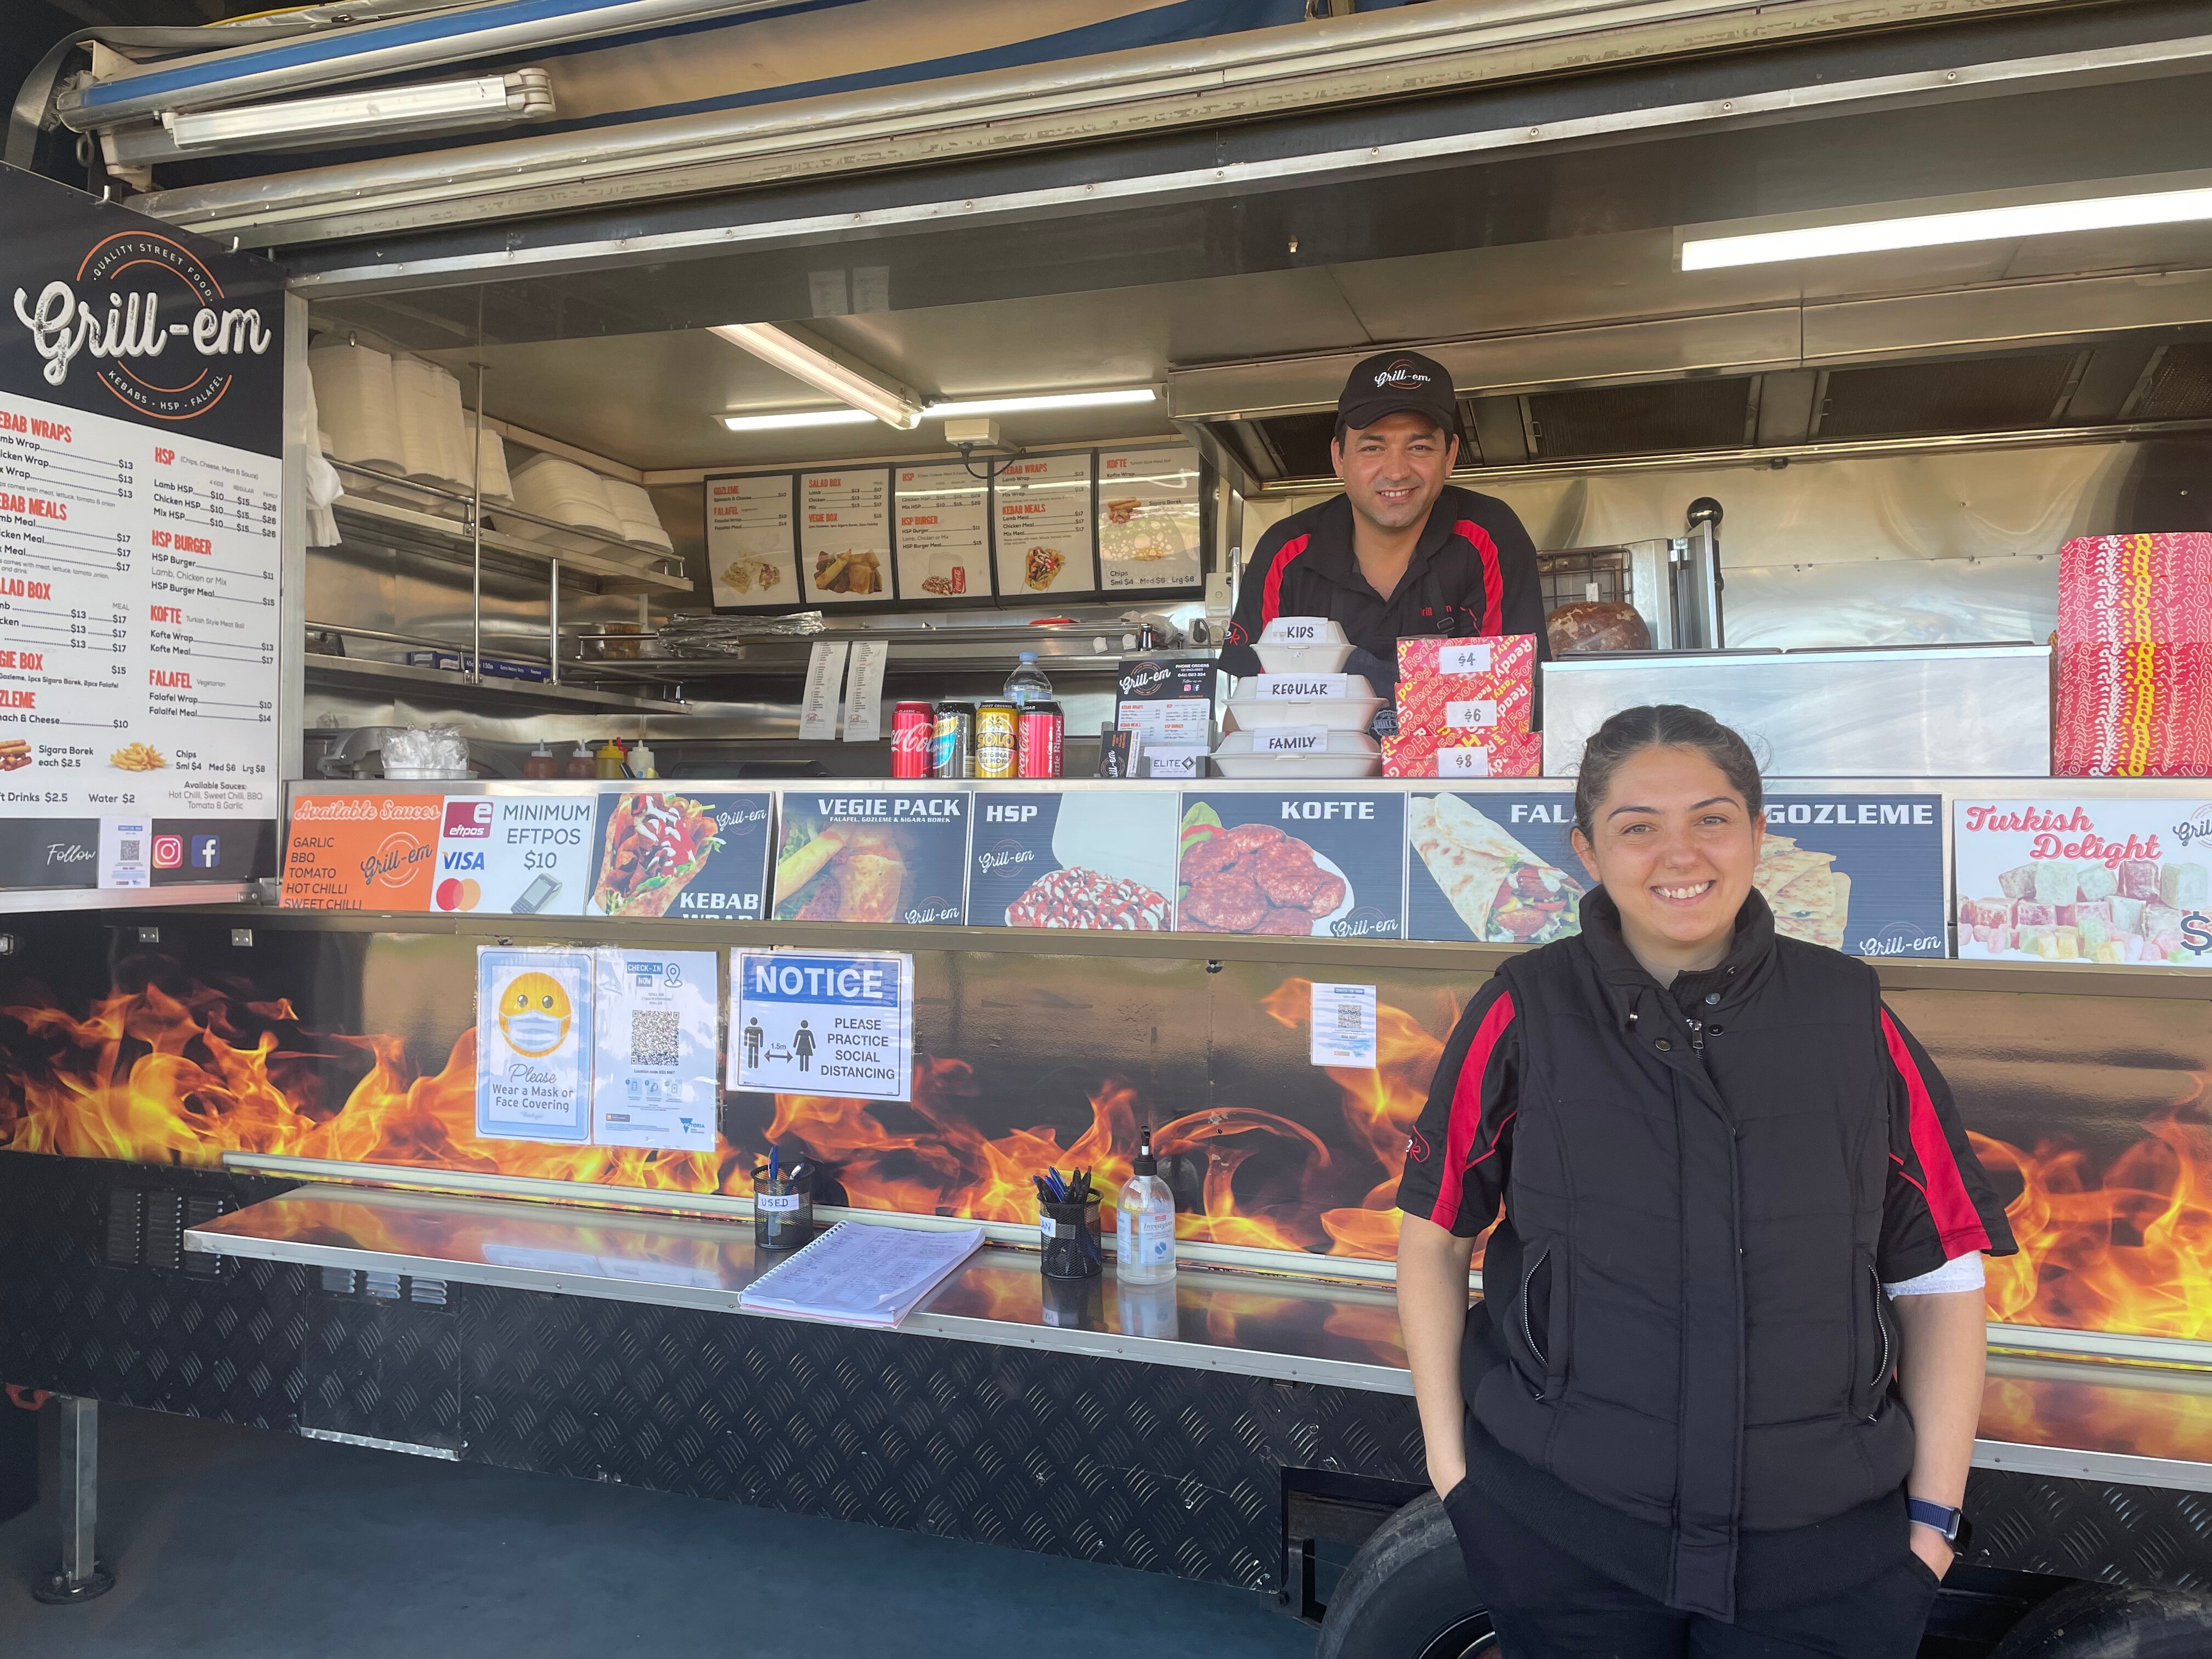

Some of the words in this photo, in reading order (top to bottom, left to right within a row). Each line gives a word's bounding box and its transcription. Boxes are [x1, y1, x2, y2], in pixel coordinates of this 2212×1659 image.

[94, 243, 134, 278] QUALITY
[139, 243, 183, 266] STREET
[188, 267, 212, 298] FOOD
[14, 281, 272, 386] Grill-em
[1374, 369, 1431, 387] Grill-em
[109, 370, 148, 404] KEBABS
[160, 401, 180, 410] HSP
[190, 375, 223, 408] FALAFEL
[31, 417, 71, 443] WRAPS
[16, 437, 40, 450] Wrap
[119, 459, 133, 470] $13
[25, 454, 49, 467] Wrap
[155, 447, 175, 465] HSP
[5, 466, 30, 479] Wrap
[154, 479, 175, 490] Lamb
[177, 484, 193, 493] HSP
[211, 491, 224, 500] $10
[238, 496, 250, 506] $15
[29, 498, 67, 521] MEALS
[154, 494, 183, 505] Chicken
[185, 499, 200, 509] HSP
[154, 507, 167, 516] Mix
[169, 510, 185, 520] HSP
[15, 514, 36, 527] Meal
[117, 533, 131, 543] $17
[24, 531, 44, 544] Meal
[152, 529, 172, 549] HSP
[174, 534, 212, 555] BURGER
[5, 546, 26, 556] Meal
[152, 553, 168, 562] HSP
[171, 556, 196, 568] Burger
[263, 571, 274, 580] $11
[28, 580, 51, 601] BOX
[151, 582, 168, 590] HSP
[170, 584, 195, 596] Burger
[197, 589, 215, 597] Meal
[263, 597, 274, 606] $15
[71, 609, 86, 618] $13
[112, 614, 126, 624] $17
[150, 605, 182, 625] KOFTE
[151, 630, 171, 640] Kofte
[173, 632, 193, 643] Wrap
[262, 642, 274, 651] $13
[1287, 627, 1314, 638] KIDS
[151, 644, 171, 653] Kofte
[173, 647, 190, 656] Meal
[262, 656, 274, 664] $17
[1458, 653, 1476, 667] $4
[20, 652, 43, 671] BOX
[111, 665, 126, 675] $15
[149, 669, 192, 689] FALAFEL
[1119, 668, 1171, 695] Grill-em
[1272, 684, 1328, 695] REGULAR
[150, 692, 176, 702] Falafel
[177, 696, 198, 704] Wrap
[259, 701, 272, 709] $10
[29, 715, 60, 724] Cheese
[113, 720, 128, 728] $10
[180, 709, 197, 717] Meal
[1464, 708, 1481, 723] $6
[977, 733, 1014, 748] SOLO
[1053, 719, 1062, 753] Ripper
[1269, 737, 1316, 749] FAMILY
[38, 745, 67, 755] Sigara
[70, 747, 93, 755] Borek
[176, 750, 196, 758] Chips
[61, 759, 81, 768] $2.5
[243, 765, 253, 774] Lrg
[1456, 754, 1472, 768] $8
[8, 792, 40, 802] Drinks
[44, 792, 67, 803] $2.5
[88, 794, 118, 803] Water
[122, 794, 135, 804] $2
[188, 801, 215, 809] Tomato
[294, 800, 377, 821] Available
[380, 800, 441, 820] Sauces
[503, 805, 590, 821] MINIMUM
[818, 799, 887, 815] VEGIE
[894, 799, 961, 816] PACK
[986, 805, 1037, 822] HSP
[1282, 802, 1374, 820] KOFTE
[1511, 804, 1577, 823] FAL
[1763, 804, 1933, 825] GOZLEME
[716, 809, 766, 831] Grill-em
[1966, 805, 2095, 832] Turkish
[449, 825, 484, 837] eftpos
[507, 828, 581, 845] EFTPOS
[2172, 819, 2212, 847] Gril
[293, 837, 335, 848] GARLIC
[46, 843, 96, 865] Follow
[291, 853, 315, 862] BBQ
[523, 850, 557, 870] $10
[2029, 833, 2163, 870] Delight
[360, 844, 433, 885] Grill-em
[441, 851, 484, 870] VISA
[979, 849, 1035, 873] Grill-em
[289, 868, 336, 878] TOMATO
[286, 883, 310, 894] HOT
[312, 883, 348, 894] CHILLI
[284, 898, 324, 910] SWEET
[326, 899, 362, 910] CHILLI
[680, 893, 759, 910] KEBAB
[905, 907, 960, 924] Grill-em
[1333, 918, 1398, 938] Grill-em
[1859, 935, 1941, 956] Grill-em
[628, 964, 661, 972] CHECK-IN
[756, 965, 883, 998] NOTICE
[835, 1018, 882, 1030] PLEASE
[827, 1034, 889, 1047] PRACTICE
[835, 1050, 880, 1062] SOCIAL
[509, 1063, 557, 1084] Please
[821, 1065, 895, 1080] DISTANCING
[493, 1084, 519, 1095] Wear
[522, 1087, 527, 1095] a
[532, 1086, 558, 1097] Mask
[562, 1088, 574, 1098] or
[496, 1097, 518, 1107] Face
[522, 1098, 569, 1113] Covering
[761, 1198, 789, 1207] USED
